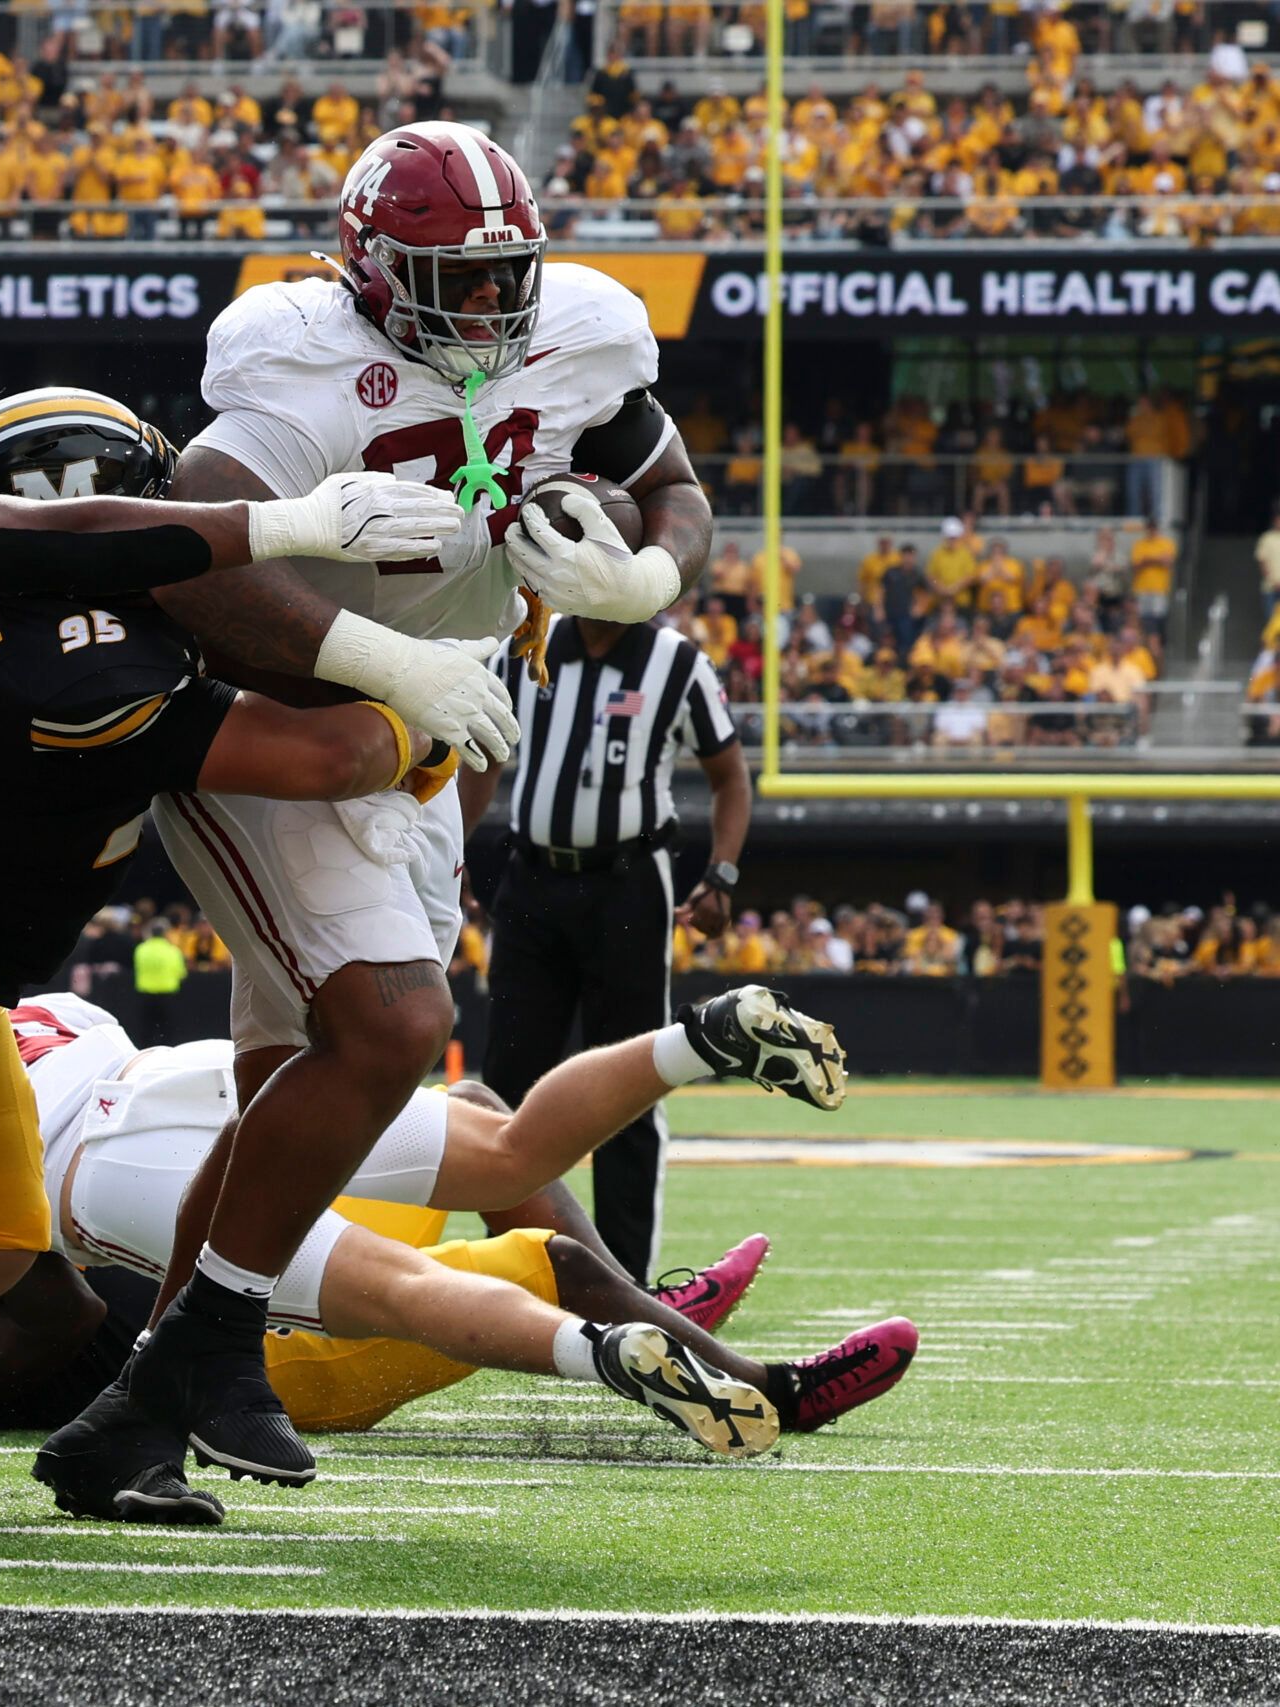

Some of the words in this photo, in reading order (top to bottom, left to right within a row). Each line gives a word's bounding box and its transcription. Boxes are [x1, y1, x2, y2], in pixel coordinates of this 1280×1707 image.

[347, 154, 392, 217] 74
[482, 230, 513, 244] BAMA
[711, 271, 969, 317] OFFICIAL
[981, 271, 1195, 316] HEALTH
[359, 367, 396, 407] SEC
[58, 609, 126, 654] 95
[606, 740, 625, 765] C
